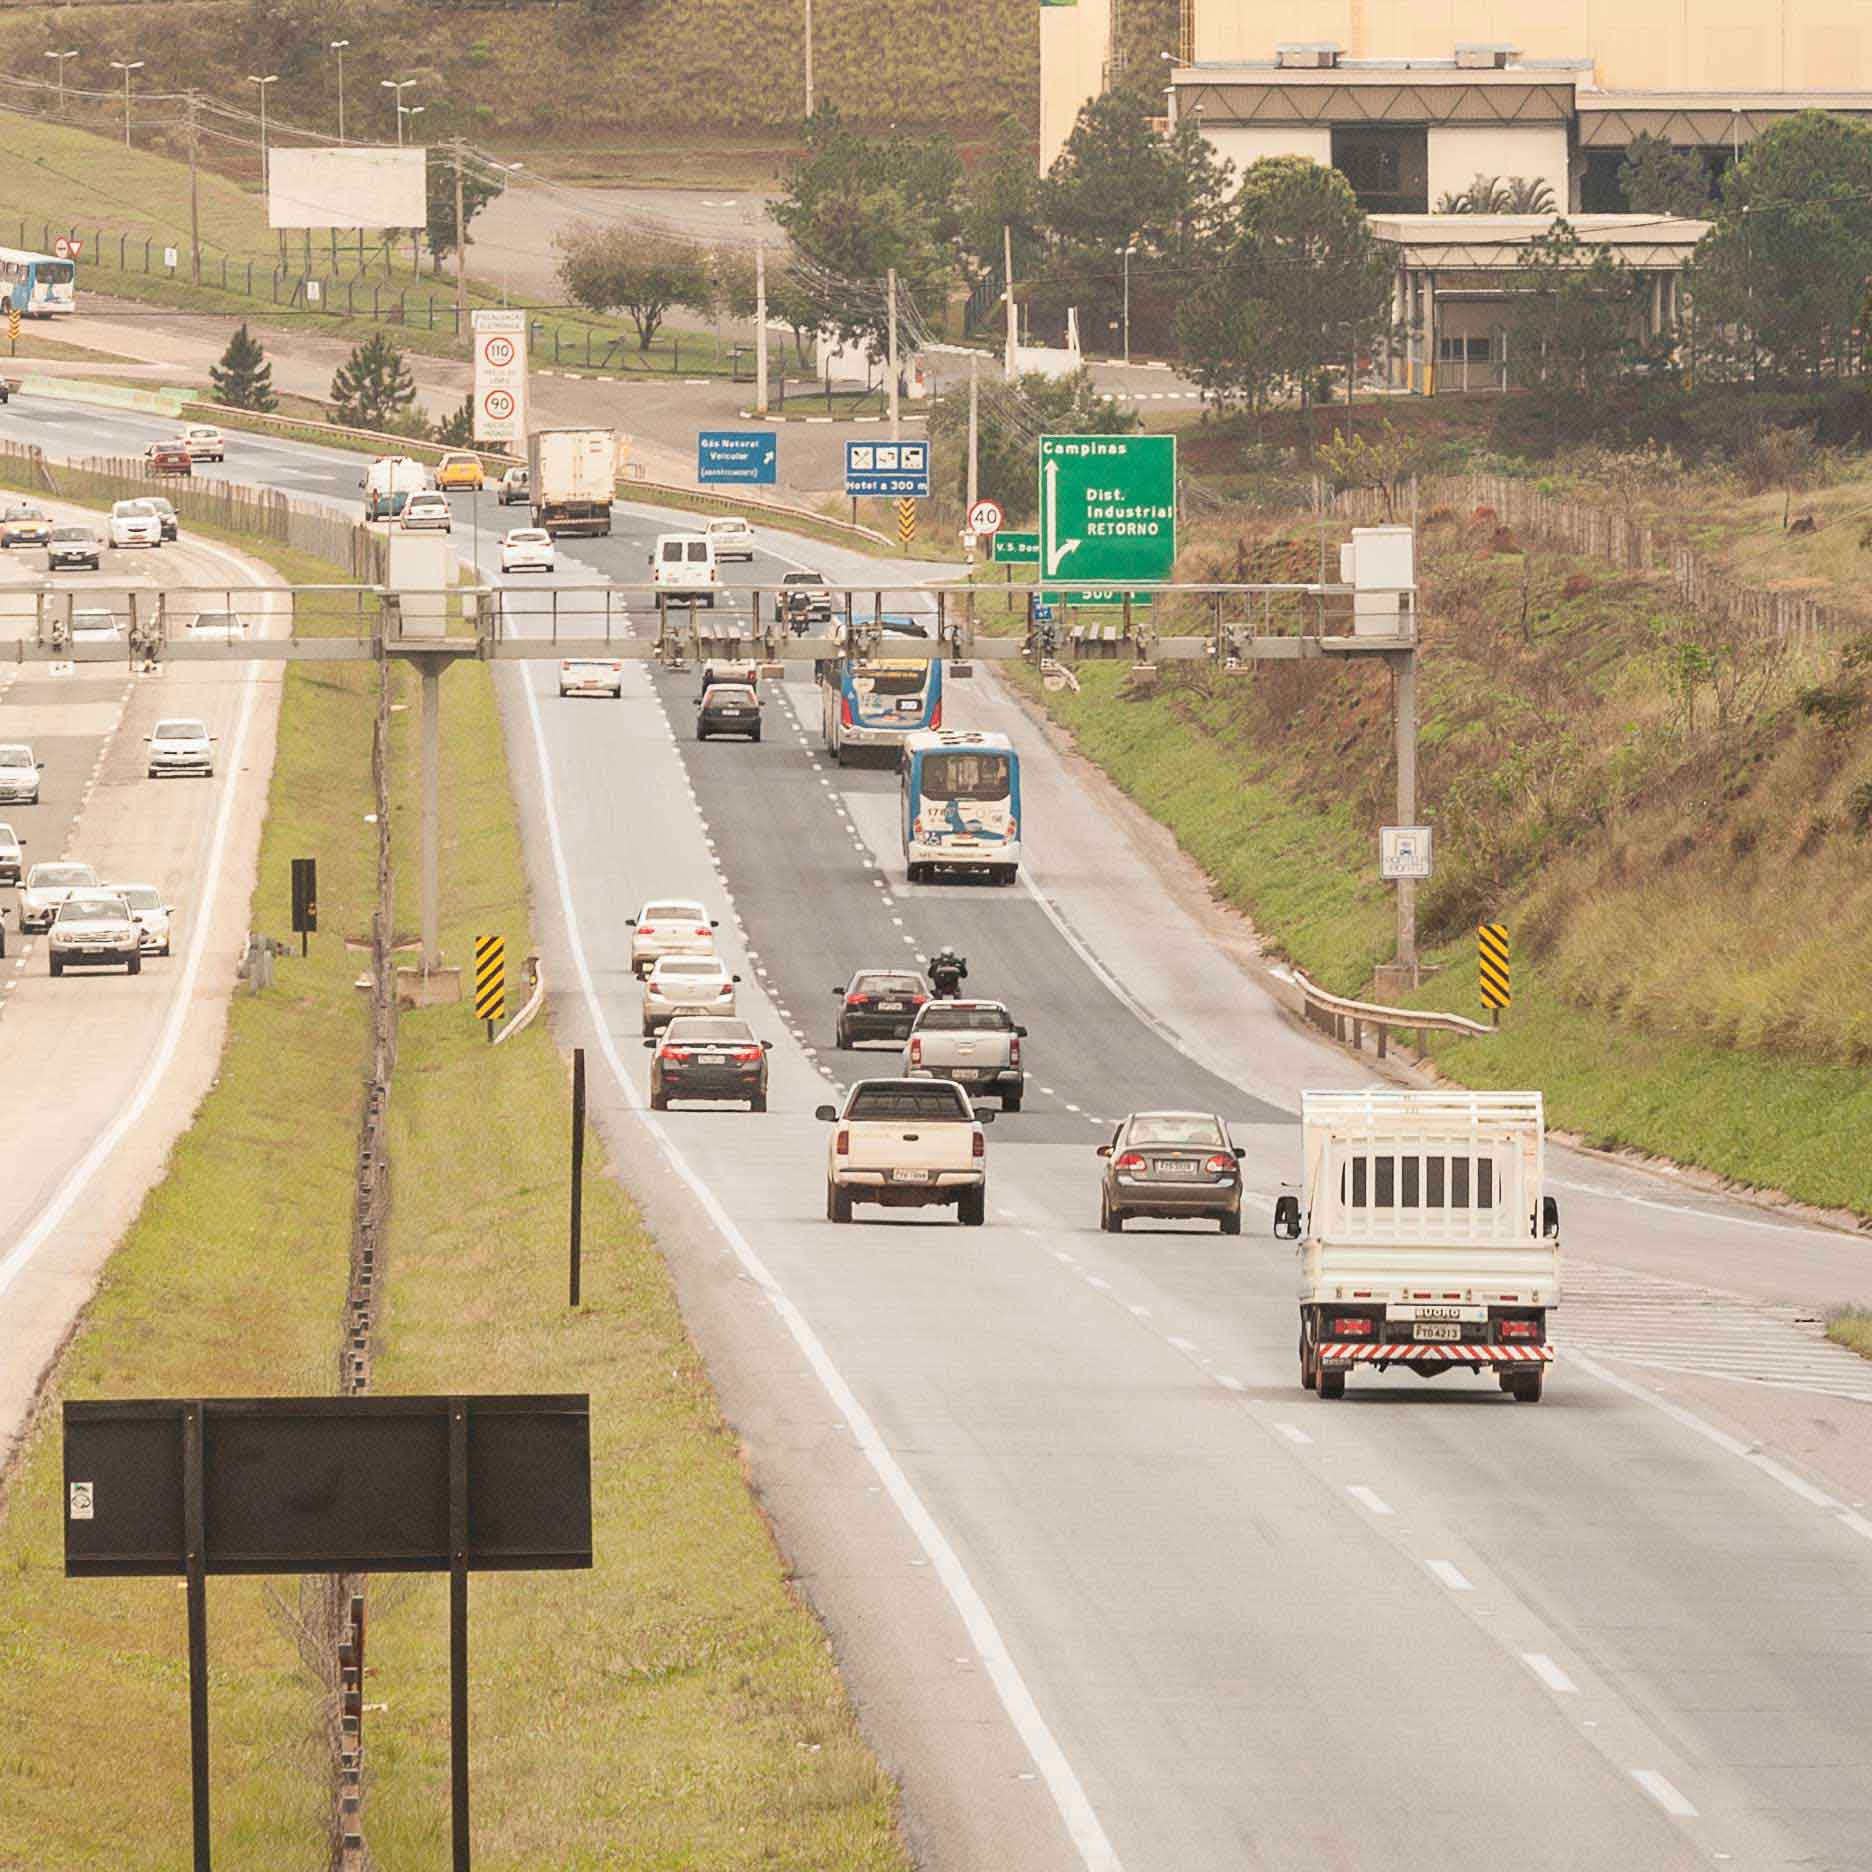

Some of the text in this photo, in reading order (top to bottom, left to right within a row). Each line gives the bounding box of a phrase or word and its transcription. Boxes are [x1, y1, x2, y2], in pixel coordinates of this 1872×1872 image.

[491, 345, 509, 358] 110
[490, 397, 509, 410] 90
[701, 438, 759, 448] Gás Natural
[1043, 441, 1127, 456] Campinas
[710, 451, 748, 460] Veicular
[847, 479, 878, 490] Hotel
[891, 480, 914, 490] 300
[1086, 488, 1126, 501] Dist.
[974, 508, 997, 525] 40
[1087, 505, 1173, 519] Industrial
[1087, 522, 1159, 536] RETORNO
